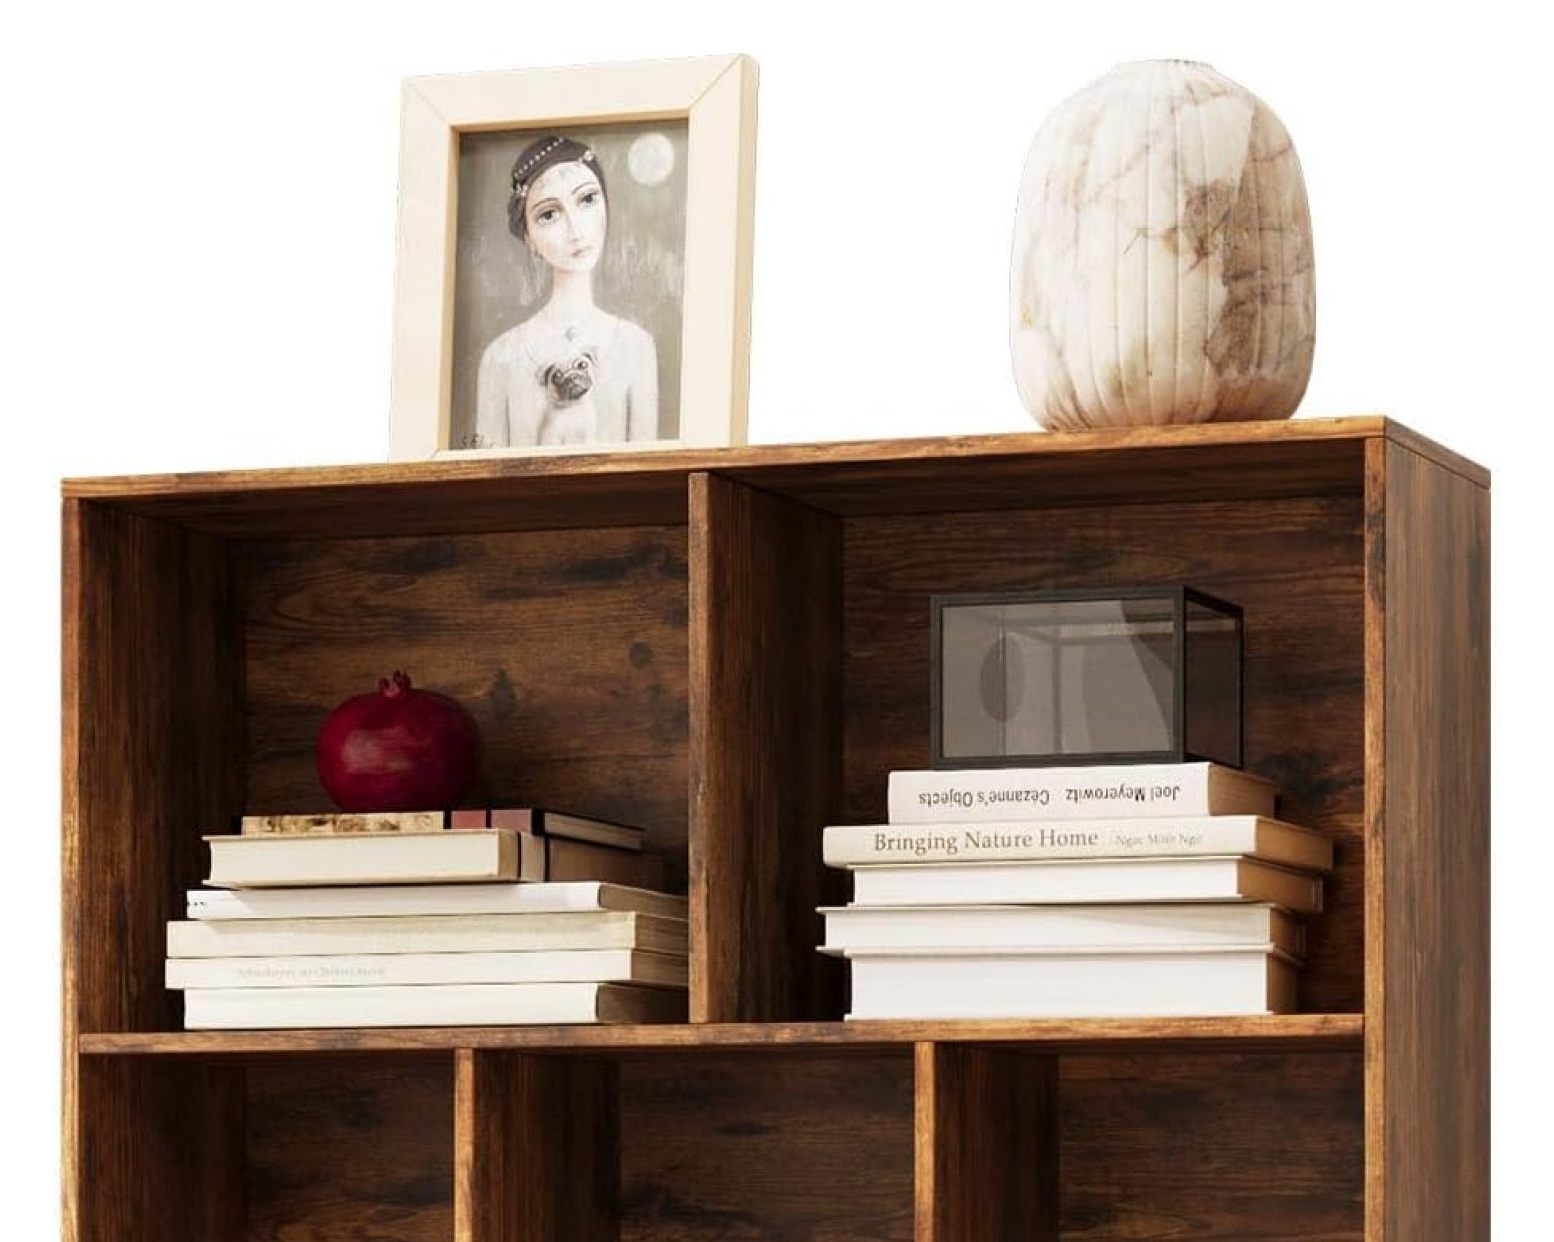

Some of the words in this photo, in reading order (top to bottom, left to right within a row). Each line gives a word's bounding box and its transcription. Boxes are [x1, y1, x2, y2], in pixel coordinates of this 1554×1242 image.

[918, 789, 974, 808] Objects
[1065, 784, 1146, 805] Meyerowitz
[1150, 785, 1181, 802] Joel
[874, 832, 958, 856] Bringing
[964, 830, 1033, 850] Nature
[1038, 828, 1099, 847] Home
